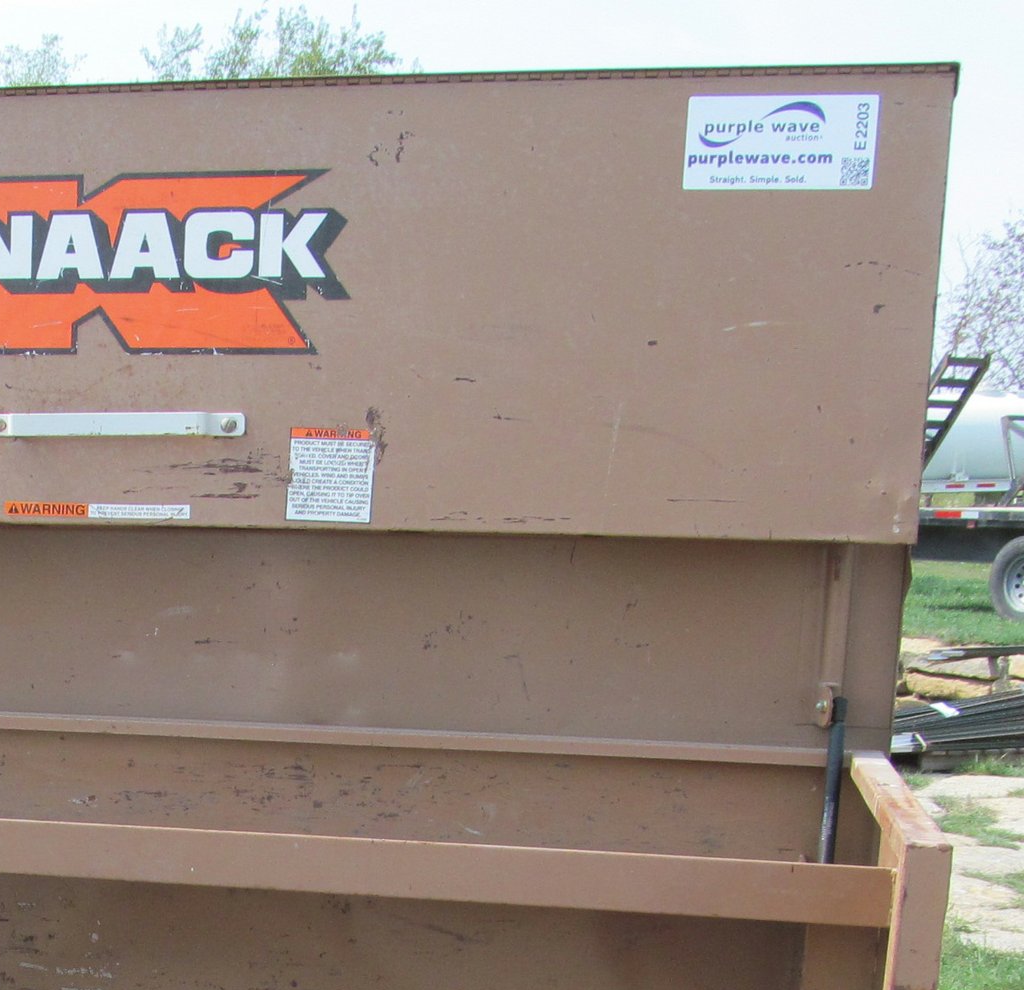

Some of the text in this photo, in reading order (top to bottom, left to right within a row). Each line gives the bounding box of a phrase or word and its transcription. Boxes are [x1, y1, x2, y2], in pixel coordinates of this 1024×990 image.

[704, 120, 820, 136] purple wave
[854, 102, 870, 150] E2203
[688, 150, 833, 167] purplewave.com
[710, 175, 807, 185] Straight. Simple. Sold.
[315, 430, 361, 438] WARNG
[20, 503, 85, 515] WARNING
